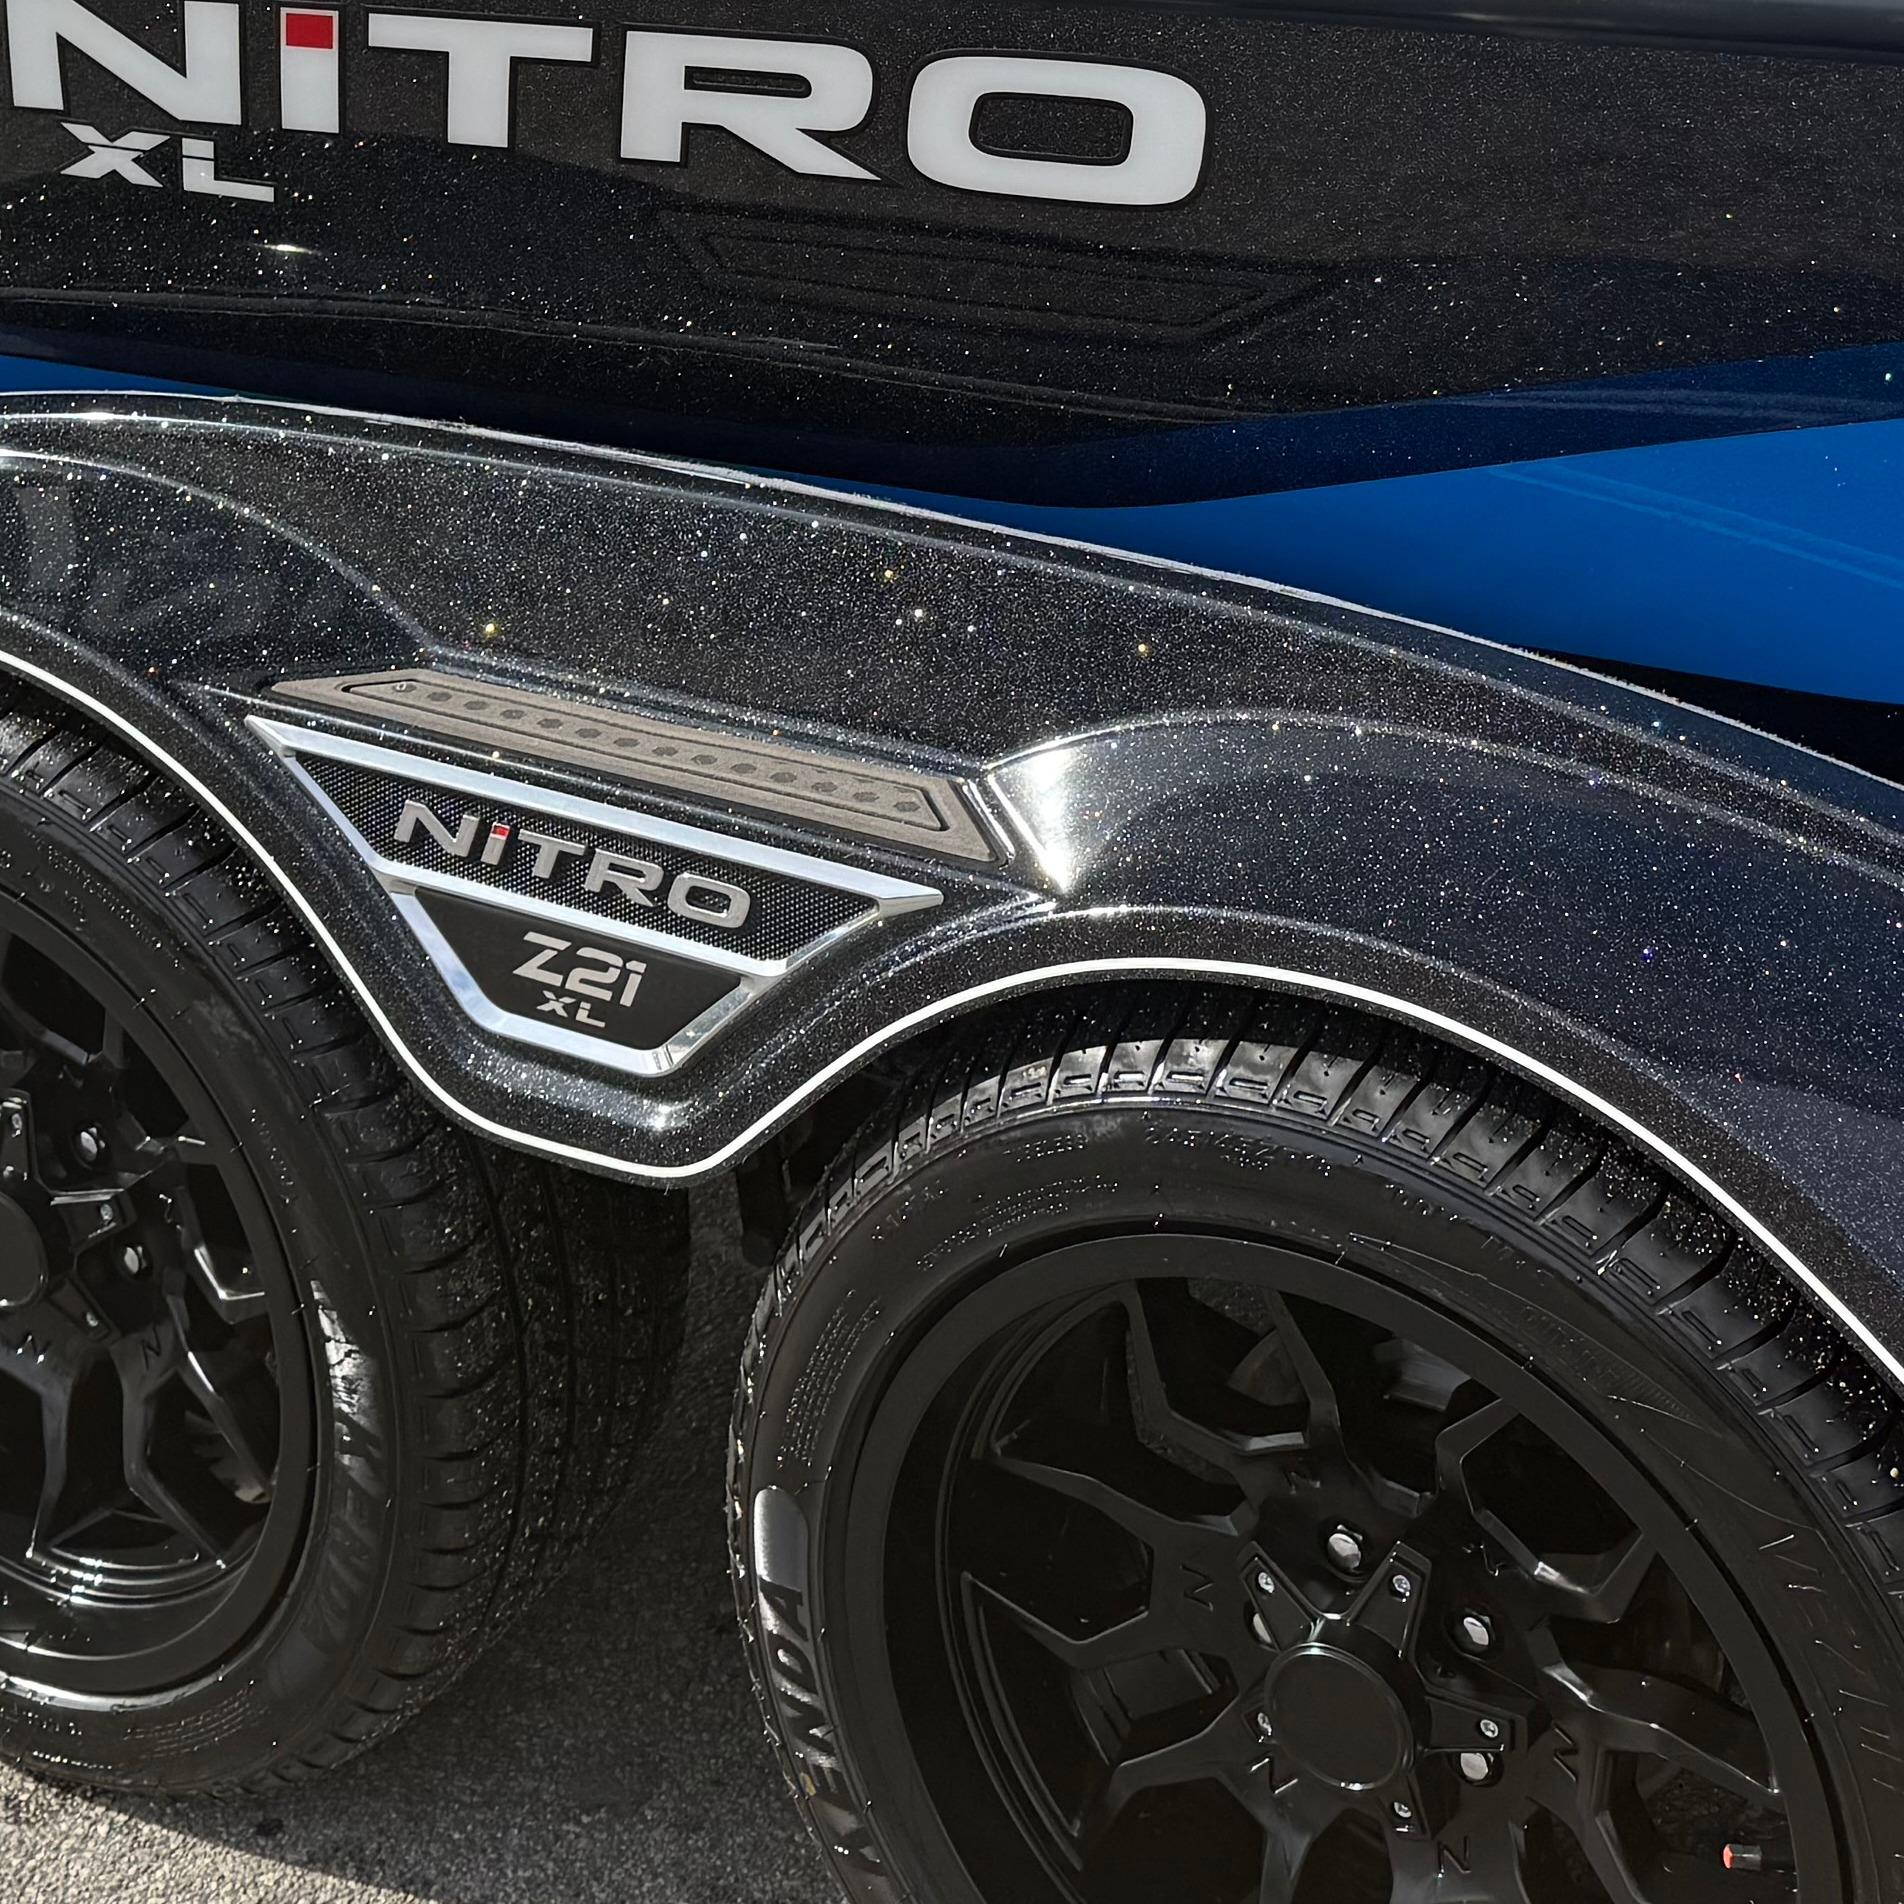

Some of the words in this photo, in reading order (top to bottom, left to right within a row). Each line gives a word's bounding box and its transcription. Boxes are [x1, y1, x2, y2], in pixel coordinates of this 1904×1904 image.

[60, 122, 275, 203] XL
[512, 931, 647, 1008] Z21
[536, 990, 606, 1028] XL
[758, 1577, 888, 1876] KENDA
